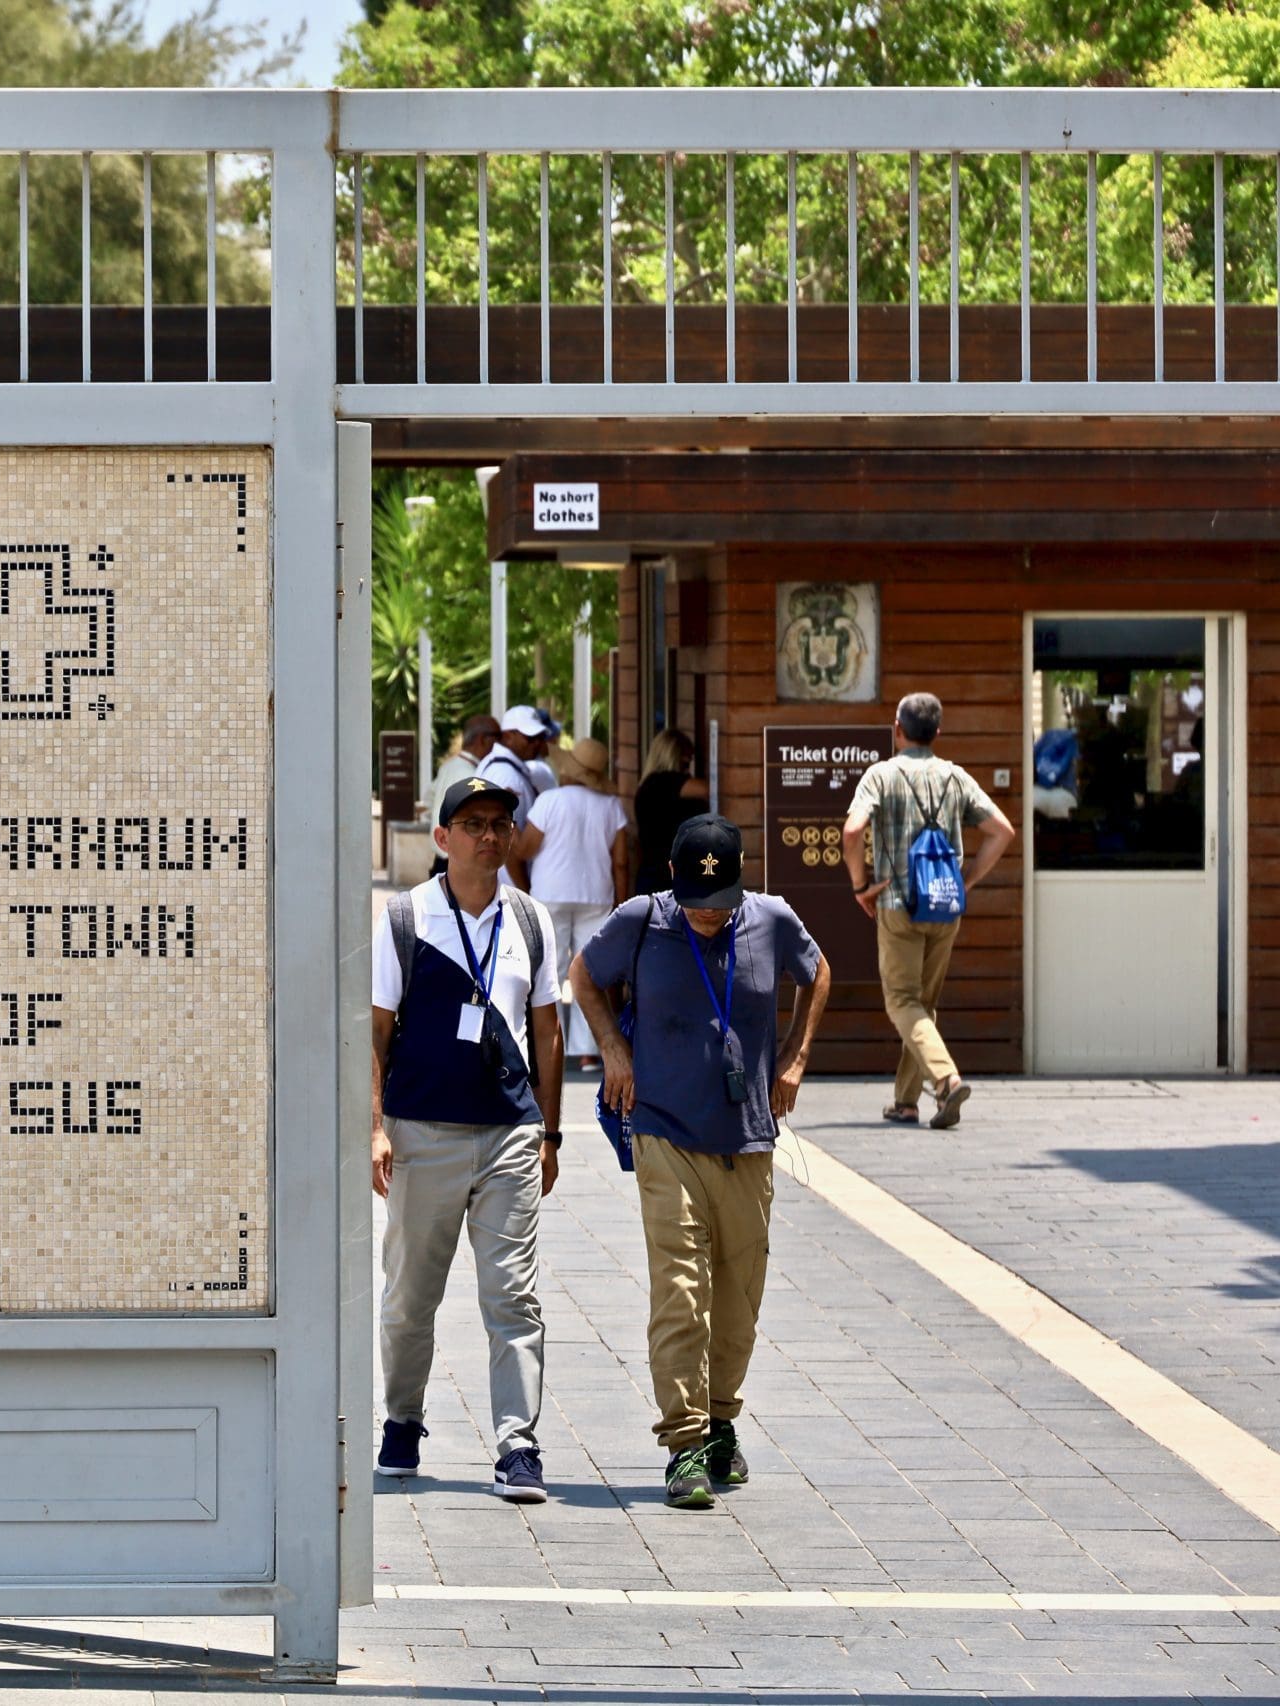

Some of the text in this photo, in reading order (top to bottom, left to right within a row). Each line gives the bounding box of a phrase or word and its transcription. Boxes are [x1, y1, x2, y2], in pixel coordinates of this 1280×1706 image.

[539, 491, 594, 503] No short
[538, 509, 594, 522] clothes
[778, 746, 880, 763] Ticket Office
[9, 905, 194, 958] TOWN
